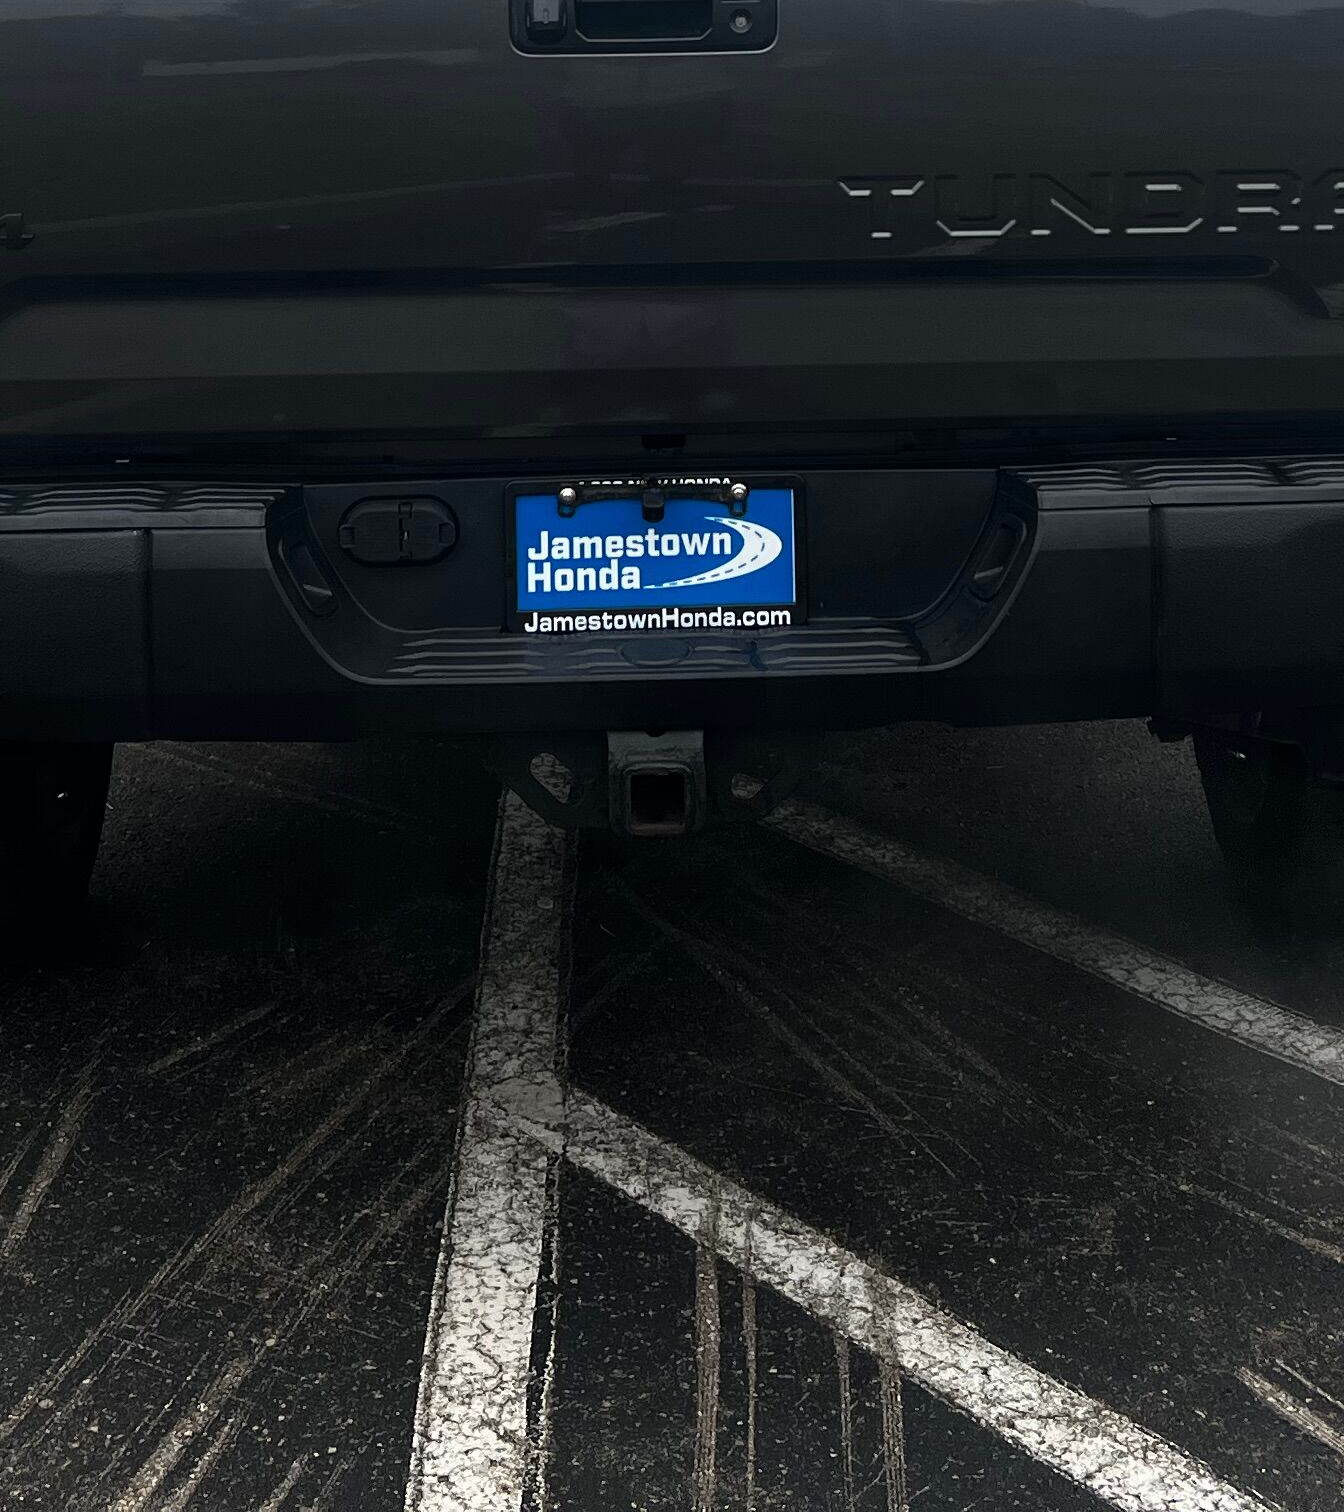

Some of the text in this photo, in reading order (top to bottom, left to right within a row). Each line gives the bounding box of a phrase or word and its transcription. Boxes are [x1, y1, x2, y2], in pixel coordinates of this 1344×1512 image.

[527, 528, 732, 561] Jamestown
[527, 559, 642, 593] Honda
[524, 606, 792, 633] JamestownHonda.com
